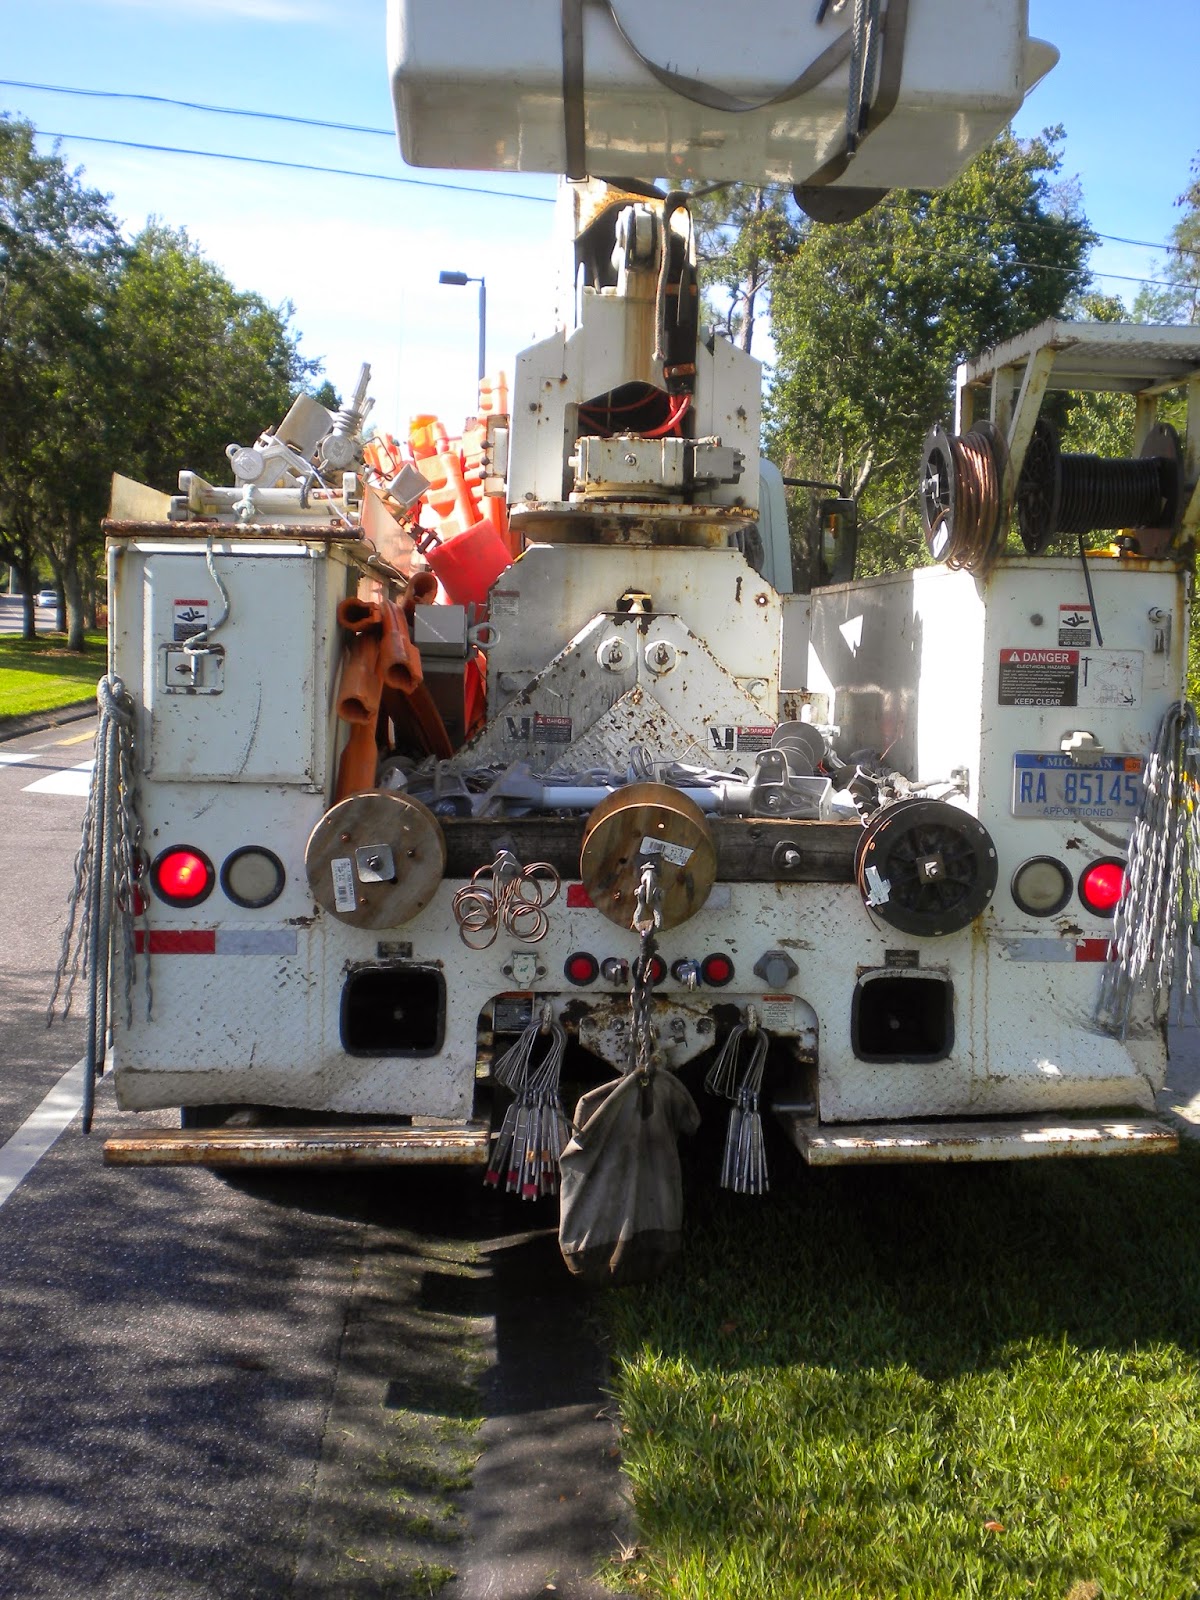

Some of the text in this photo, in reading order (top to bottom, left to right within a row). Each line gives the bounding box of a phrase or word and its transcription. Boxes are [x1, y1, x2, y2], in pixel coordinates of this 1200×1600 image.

[1023, 652, 1069, 663] DANGER
[1036, 698, 1061, 706] CLEAR
[1021, 771, 1138, 806] RA 85145
[1043, 807, 1114, 817] APPORTIONED
